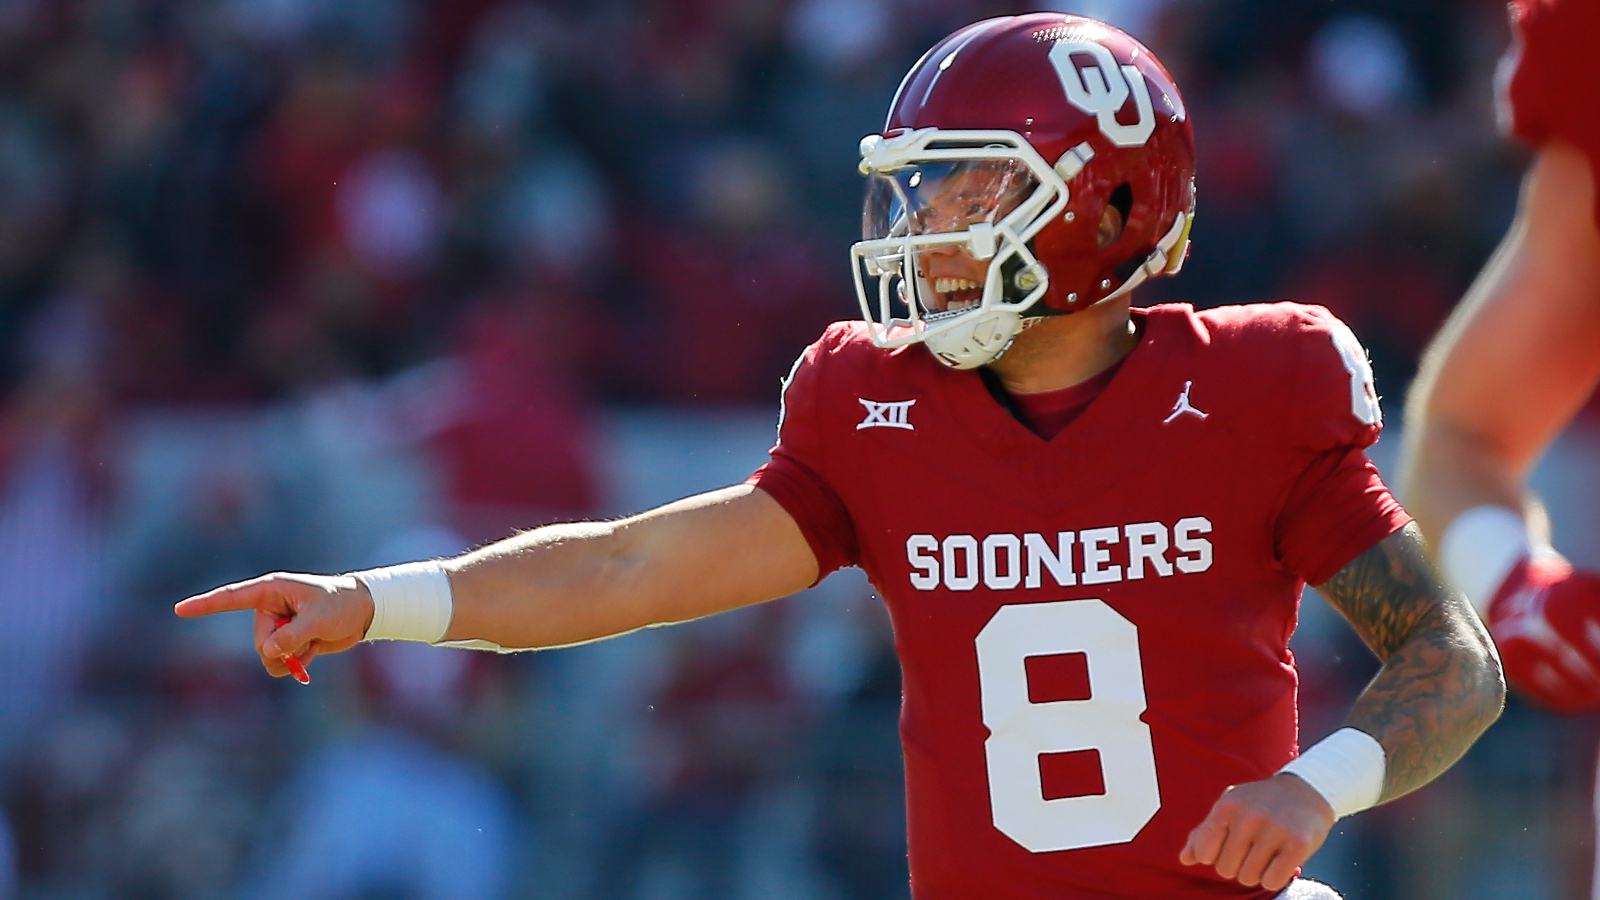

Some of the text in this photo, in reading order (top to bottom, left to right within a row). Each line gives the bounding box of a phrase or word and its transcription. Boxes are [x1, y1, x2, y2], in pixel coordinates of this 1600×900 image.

[1048, 41, 1157, 147] OU
[856, 398, 916, 430] XII
[1331, 324, 1383, 425] 8
[906, 516, 1213, 591] SOONERS
[974, 598, 1162, 853] 8
